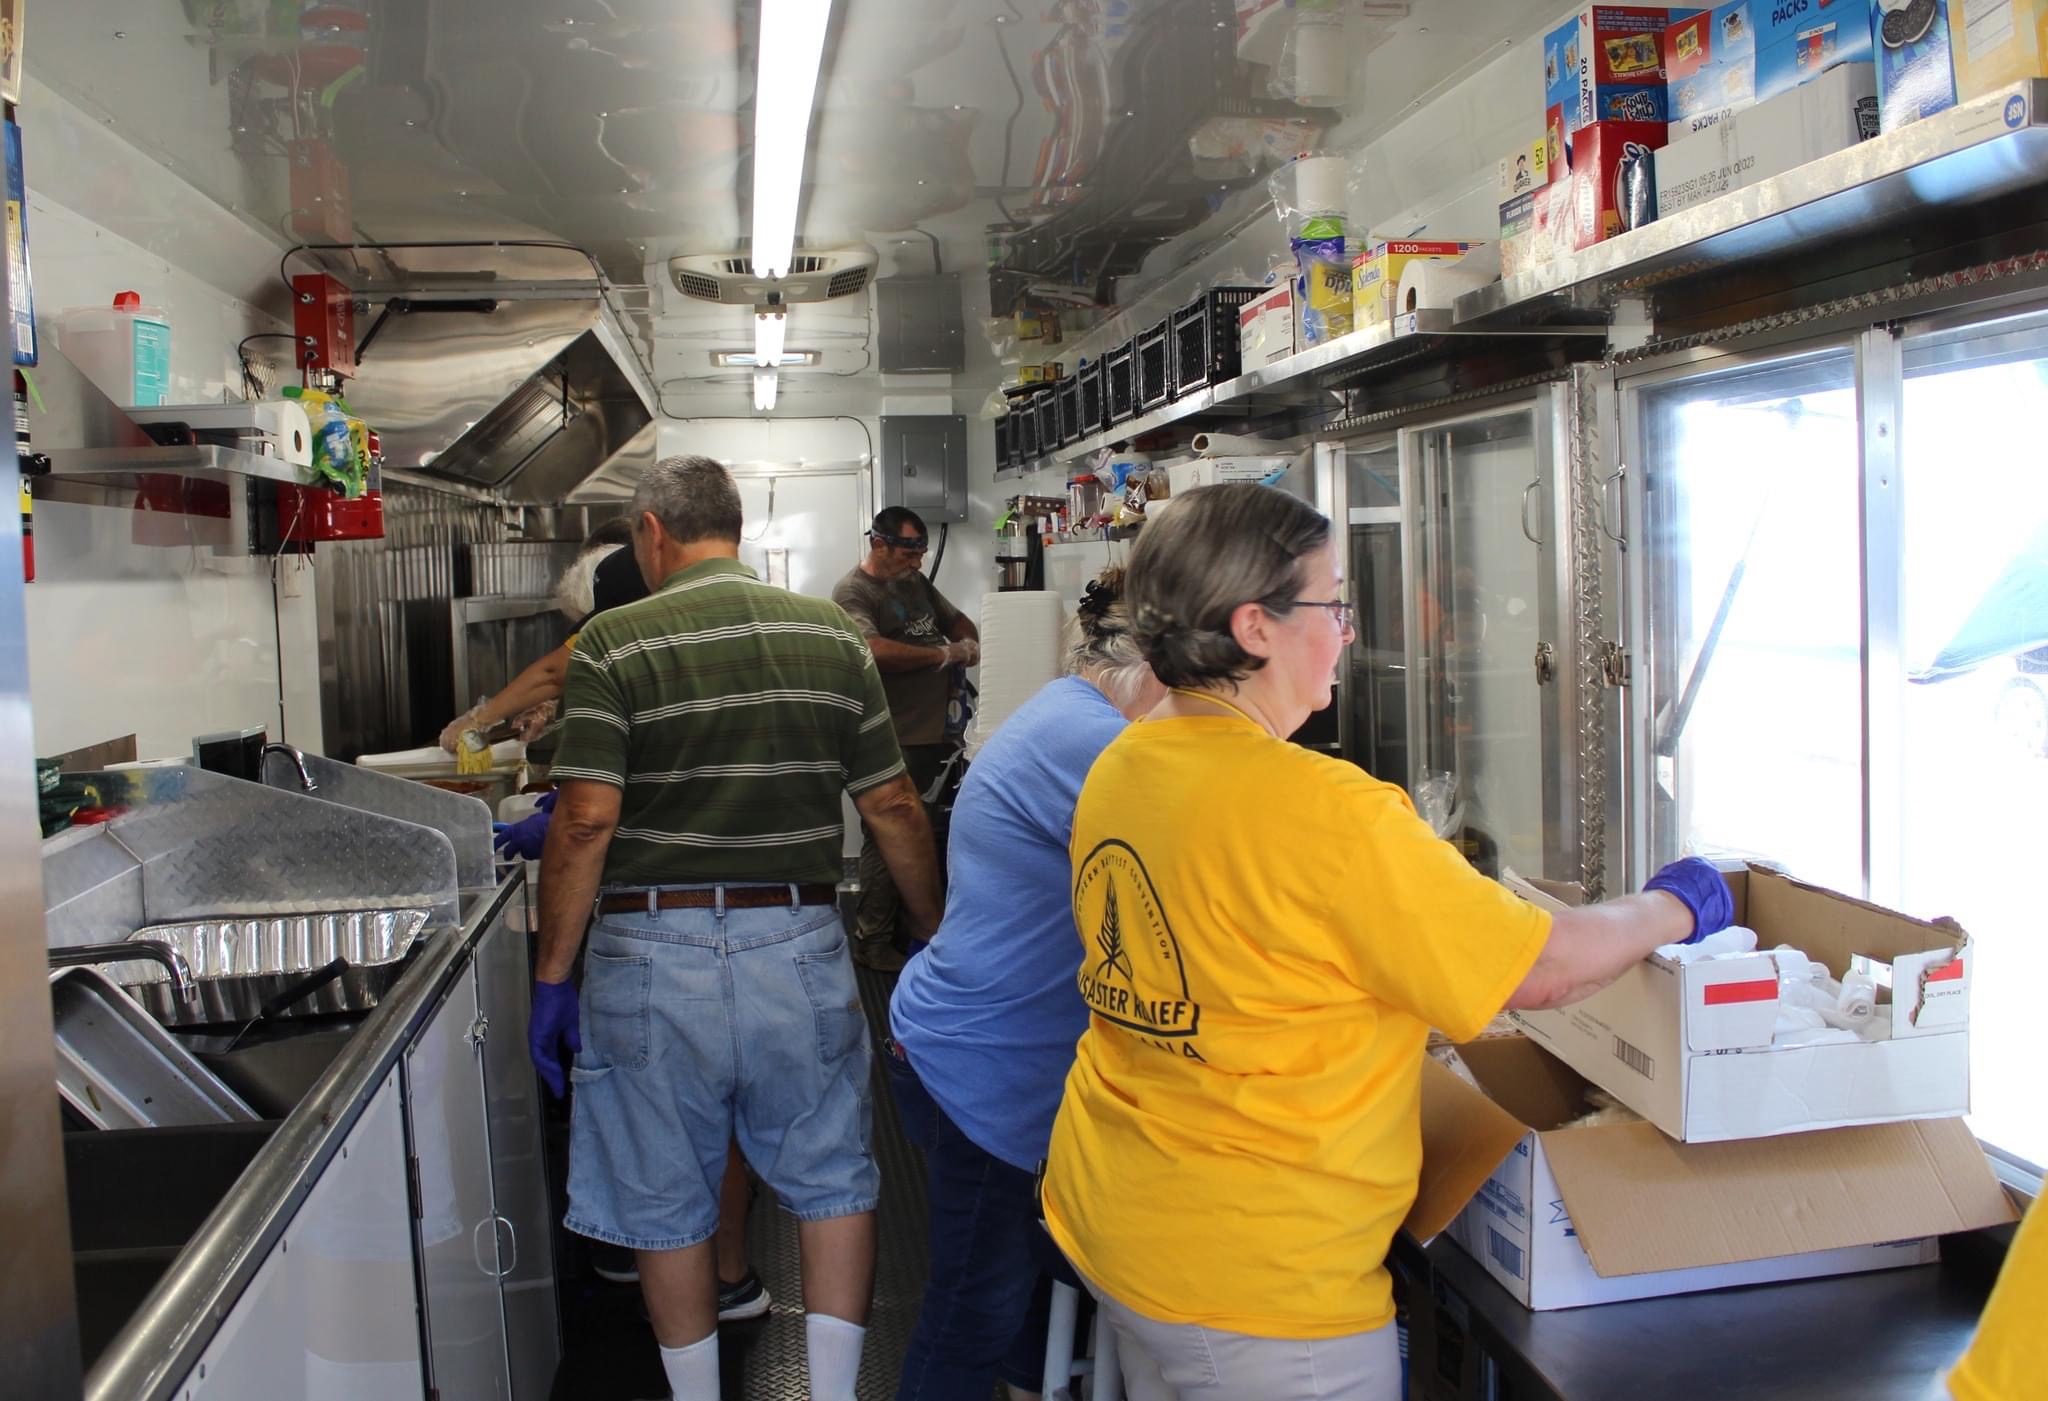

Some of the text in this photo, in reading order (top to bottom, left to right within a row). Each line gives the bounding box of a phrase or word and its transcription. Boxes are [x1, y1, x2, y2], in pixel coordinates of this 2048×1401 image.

[1771, 0, 1808, 27] PACKS
[1580, 57, 1588, 75] 20
[1692, 114, 1719, 133] PACKS
[1861, 113, 1879, 121] TOMA
[1718, 165, 1732, 179] JUN
[1394, 244, 1418, 253] 1200
[1079, 972, 1129, 1015] ISASTER
